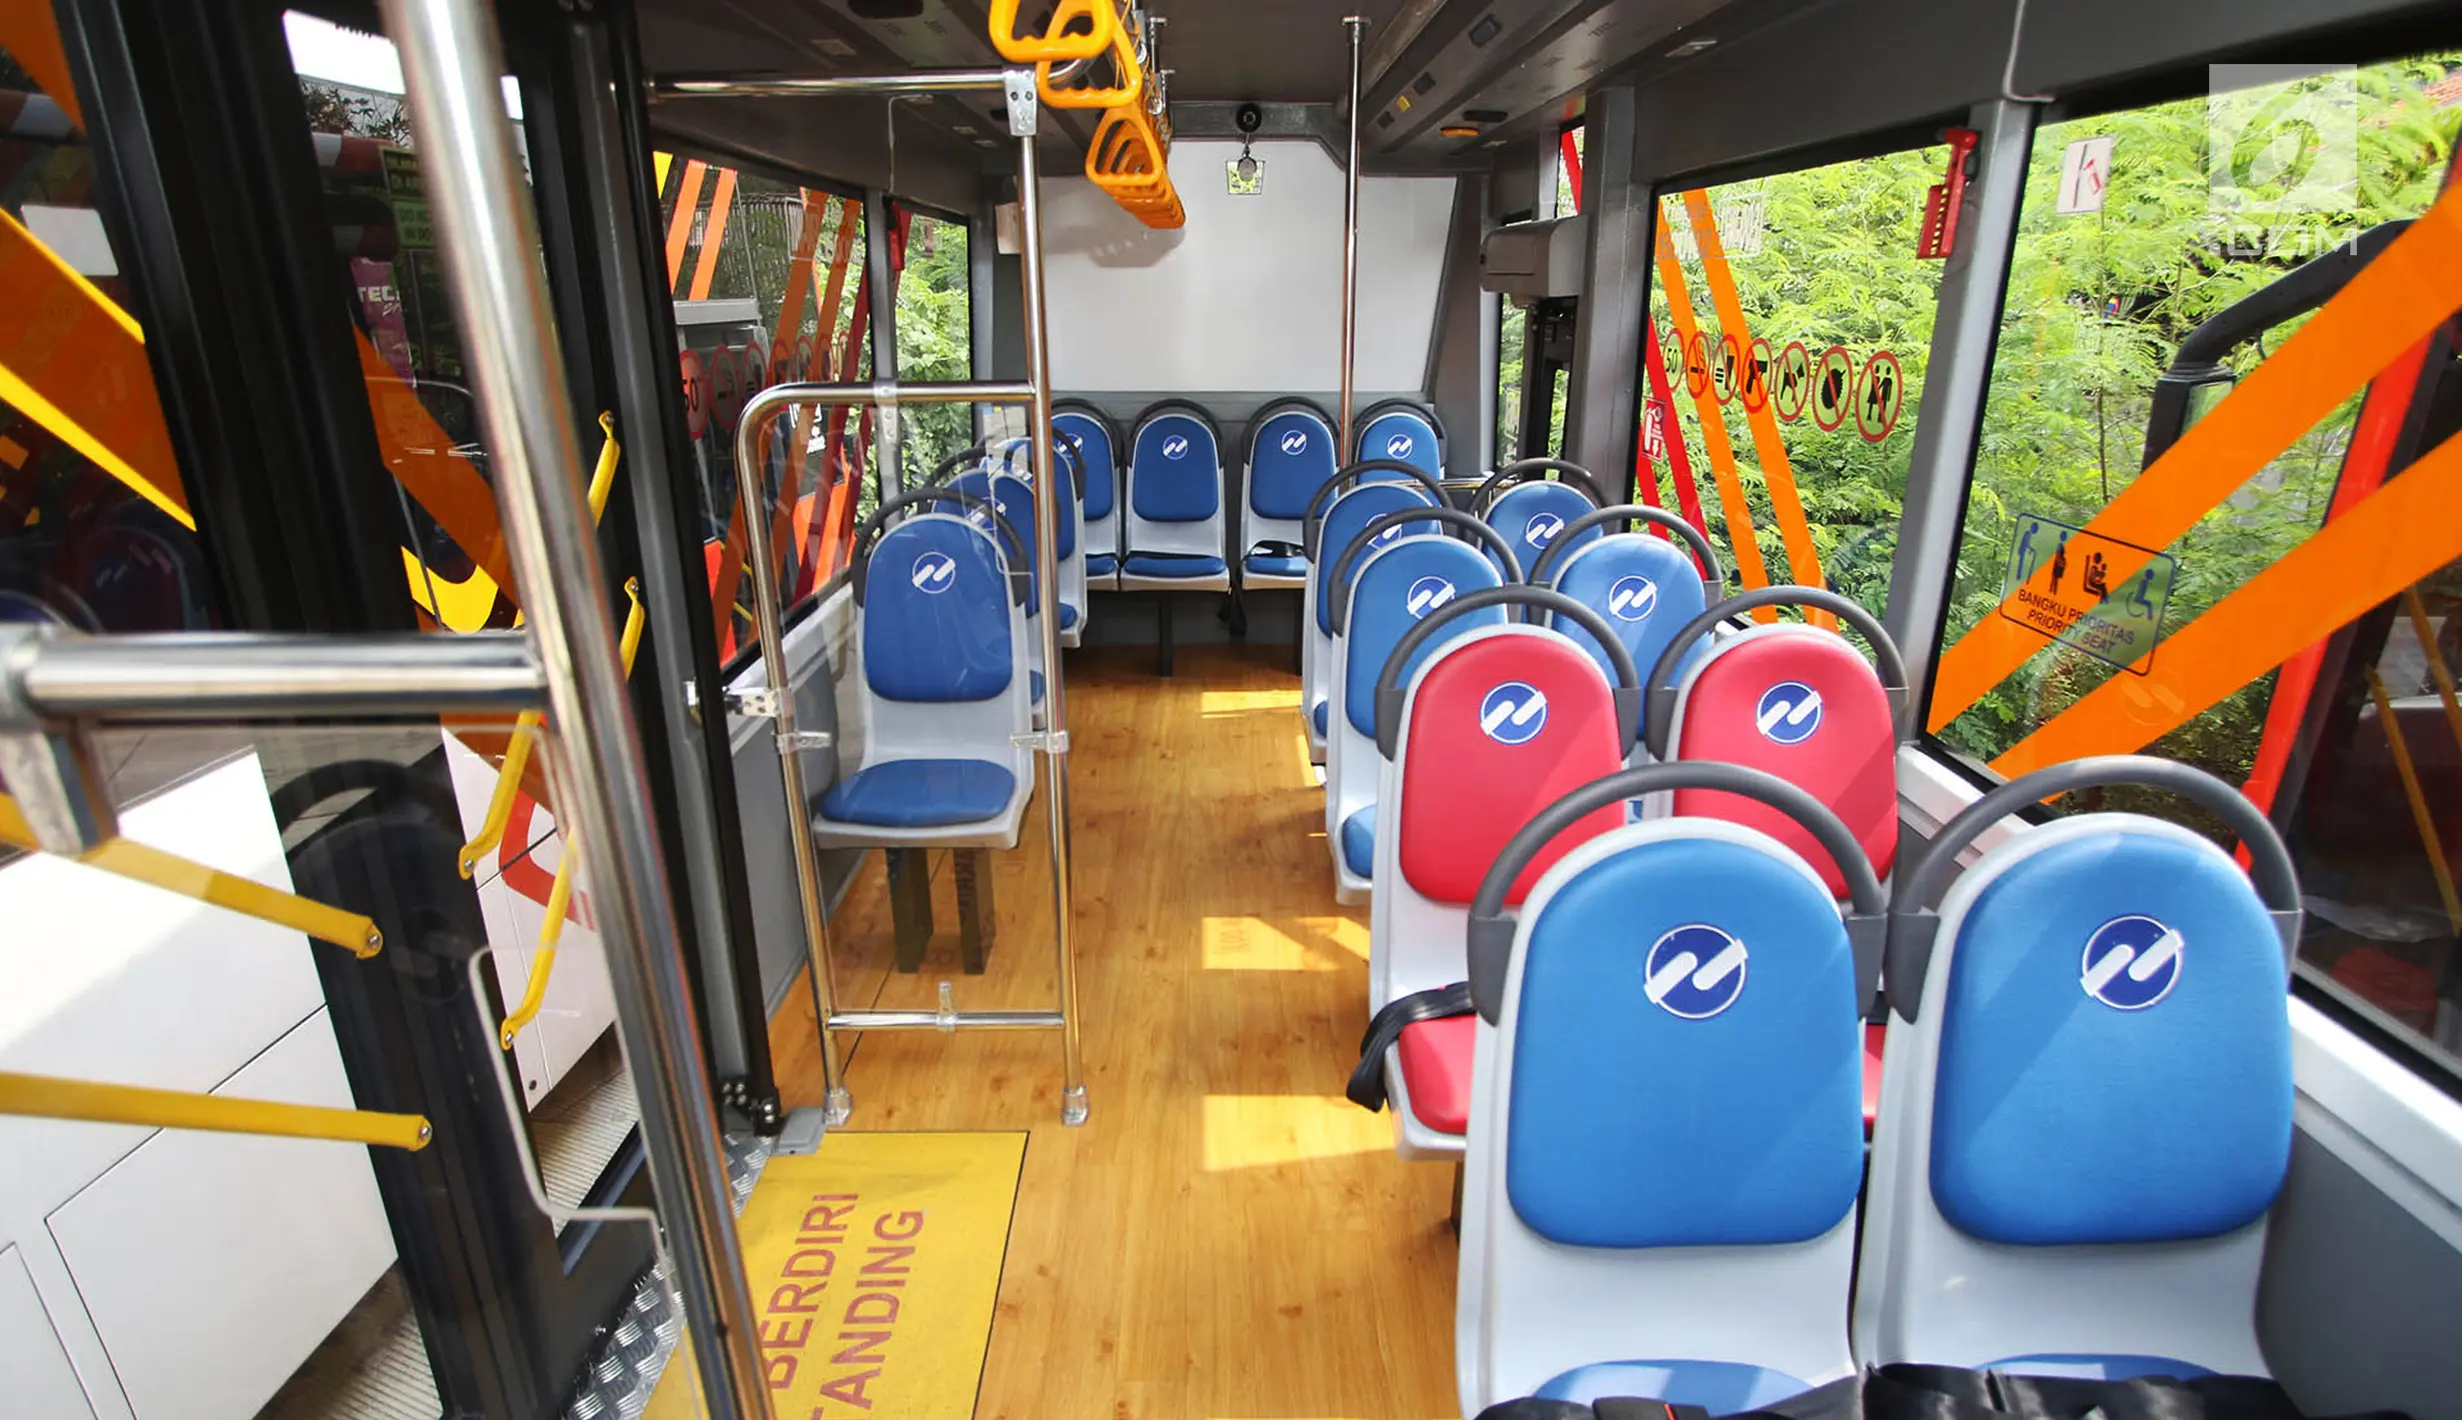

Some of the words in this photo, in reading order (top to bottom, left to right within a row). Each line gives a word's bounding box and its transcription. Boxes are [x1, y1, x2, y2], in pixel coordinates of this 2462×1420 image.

[1665, 347, 1679, 374] 50
[2018, 588, 2067, 618] BANGKU
[2068, 607, 2135, 645] PRIORITAS
[2028, 609, 2081, 641] PRIORITY
[2082, 631, 2116, 654] SEAT
[759, 1193, 859, 1389] BERDIRI
